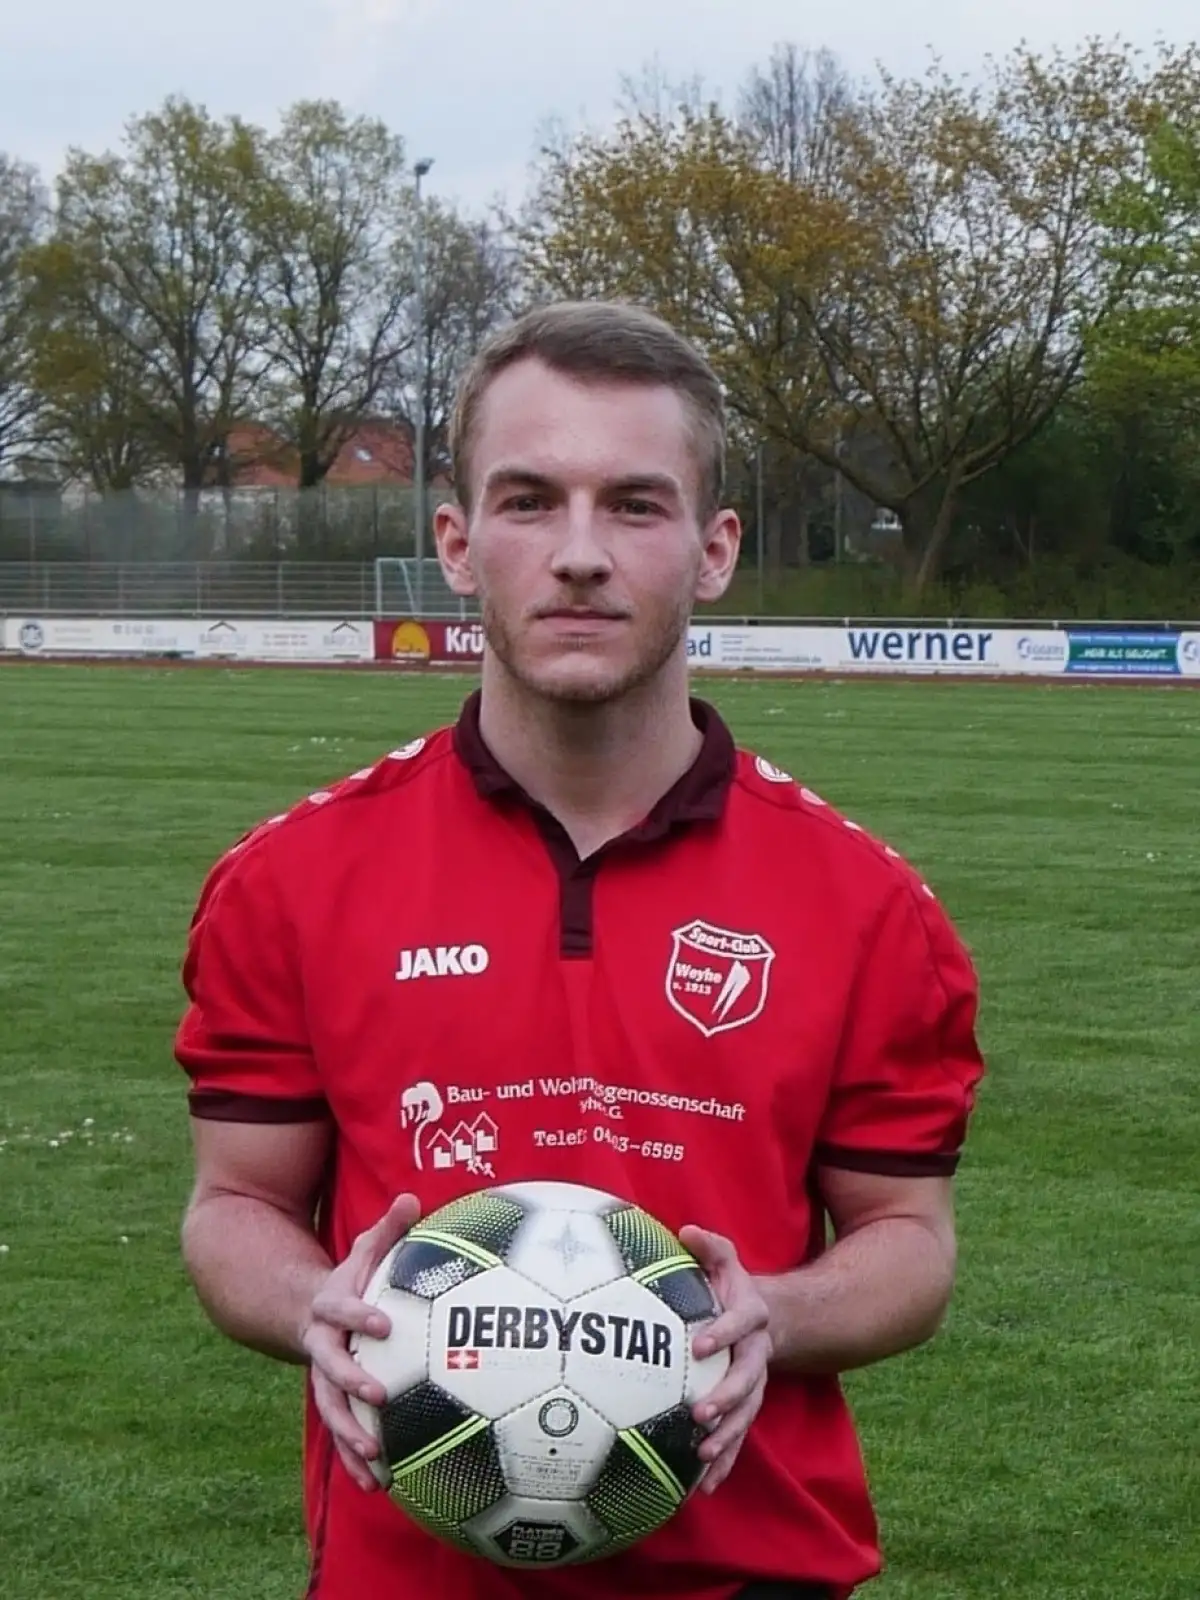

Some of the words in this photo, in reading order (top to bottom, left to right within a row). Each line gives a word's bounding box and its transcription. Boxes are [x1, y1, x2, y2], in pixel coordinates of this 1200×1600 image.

[848, 631, 992, 661] werner
[689, 926, 761, 954] Sport-Club
[395, 944, 489, 980] JAKO
[675, 963, 722, 984] Weyhe
[447, 1085, 491, 1104] Bau-
[496, 1079, 533, 1098] und
[447, 1306, 671, 1368] DERBYSTAR
